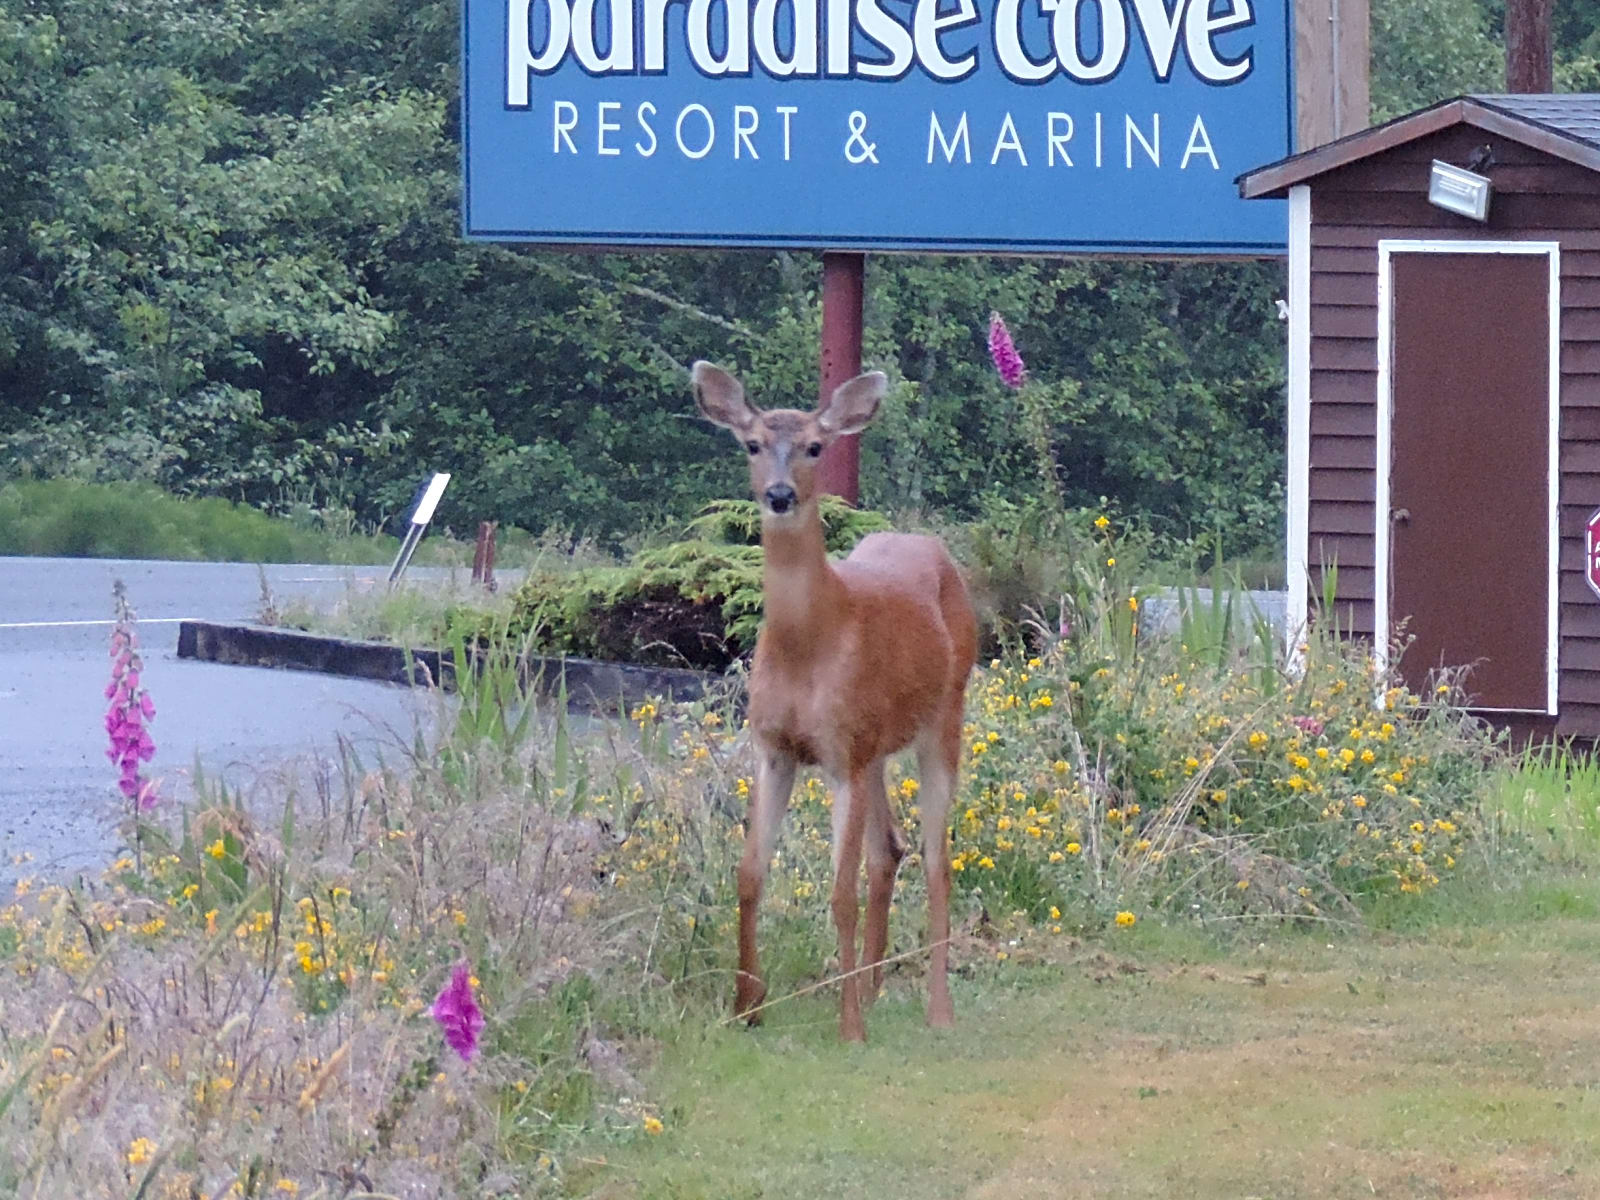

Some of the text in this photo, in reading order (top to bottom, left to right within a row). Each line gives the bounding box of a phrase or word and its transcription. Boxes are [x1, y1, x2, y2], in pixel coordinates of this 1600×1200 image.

[553, 100, 1220, 171] RESORT & MARINA
